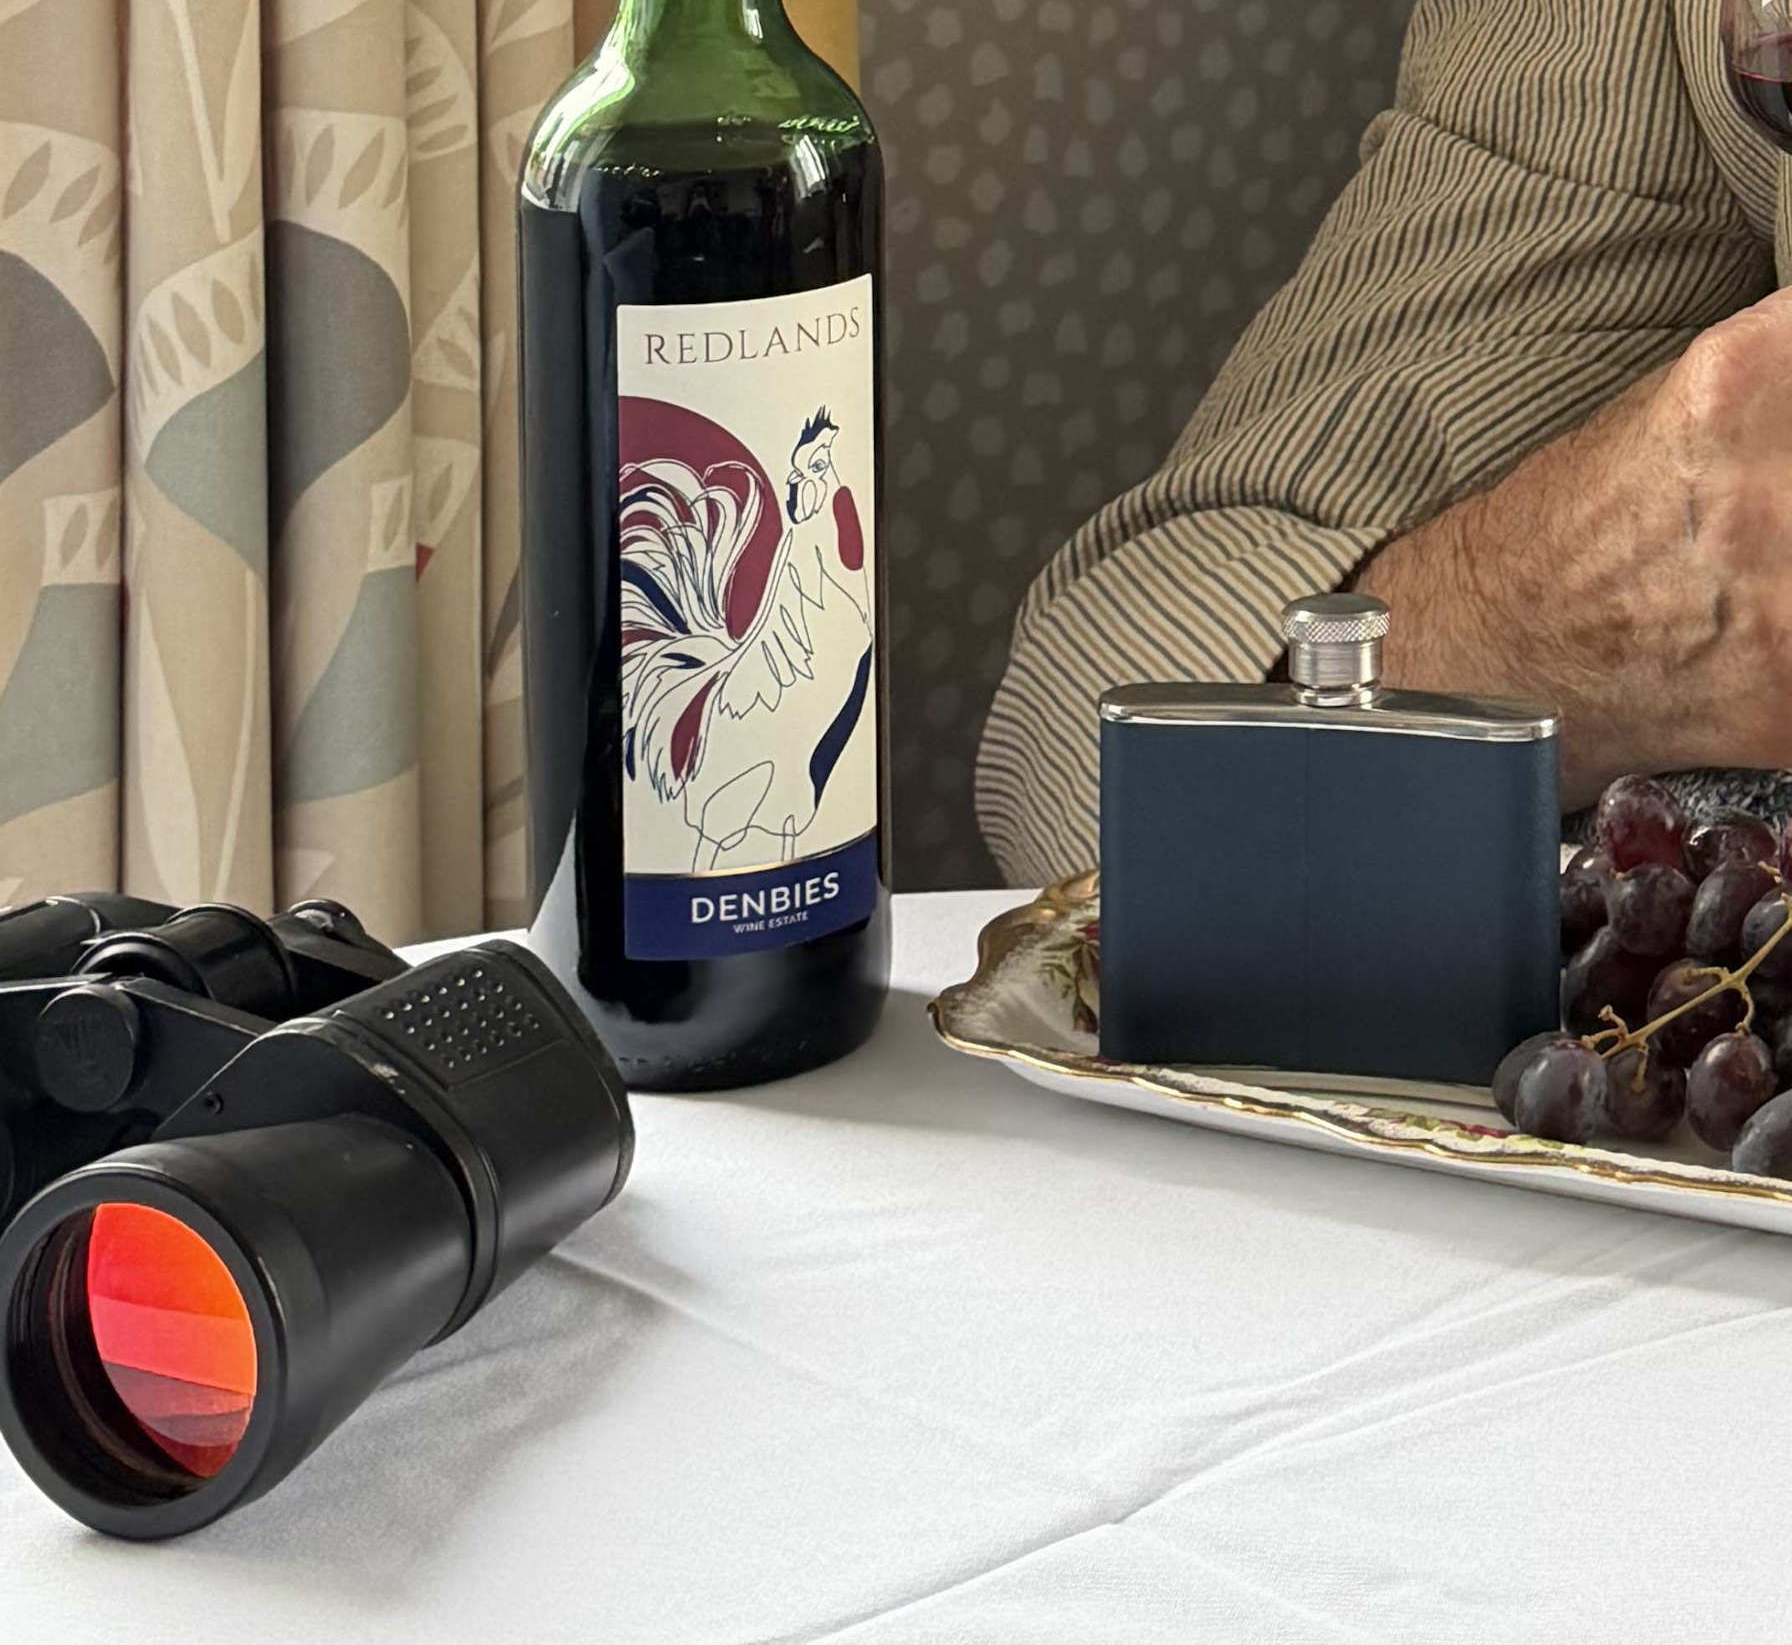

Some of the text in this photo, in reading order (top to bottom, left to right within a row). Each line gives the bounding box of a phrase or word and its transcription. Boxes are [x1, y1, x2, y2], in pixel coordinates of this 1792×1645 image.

[644, 306, 860, 365] REDLANDS
[691, 871, 840, 923] DENBIES
[733, 911, 809, 934] WINE ESTATE
